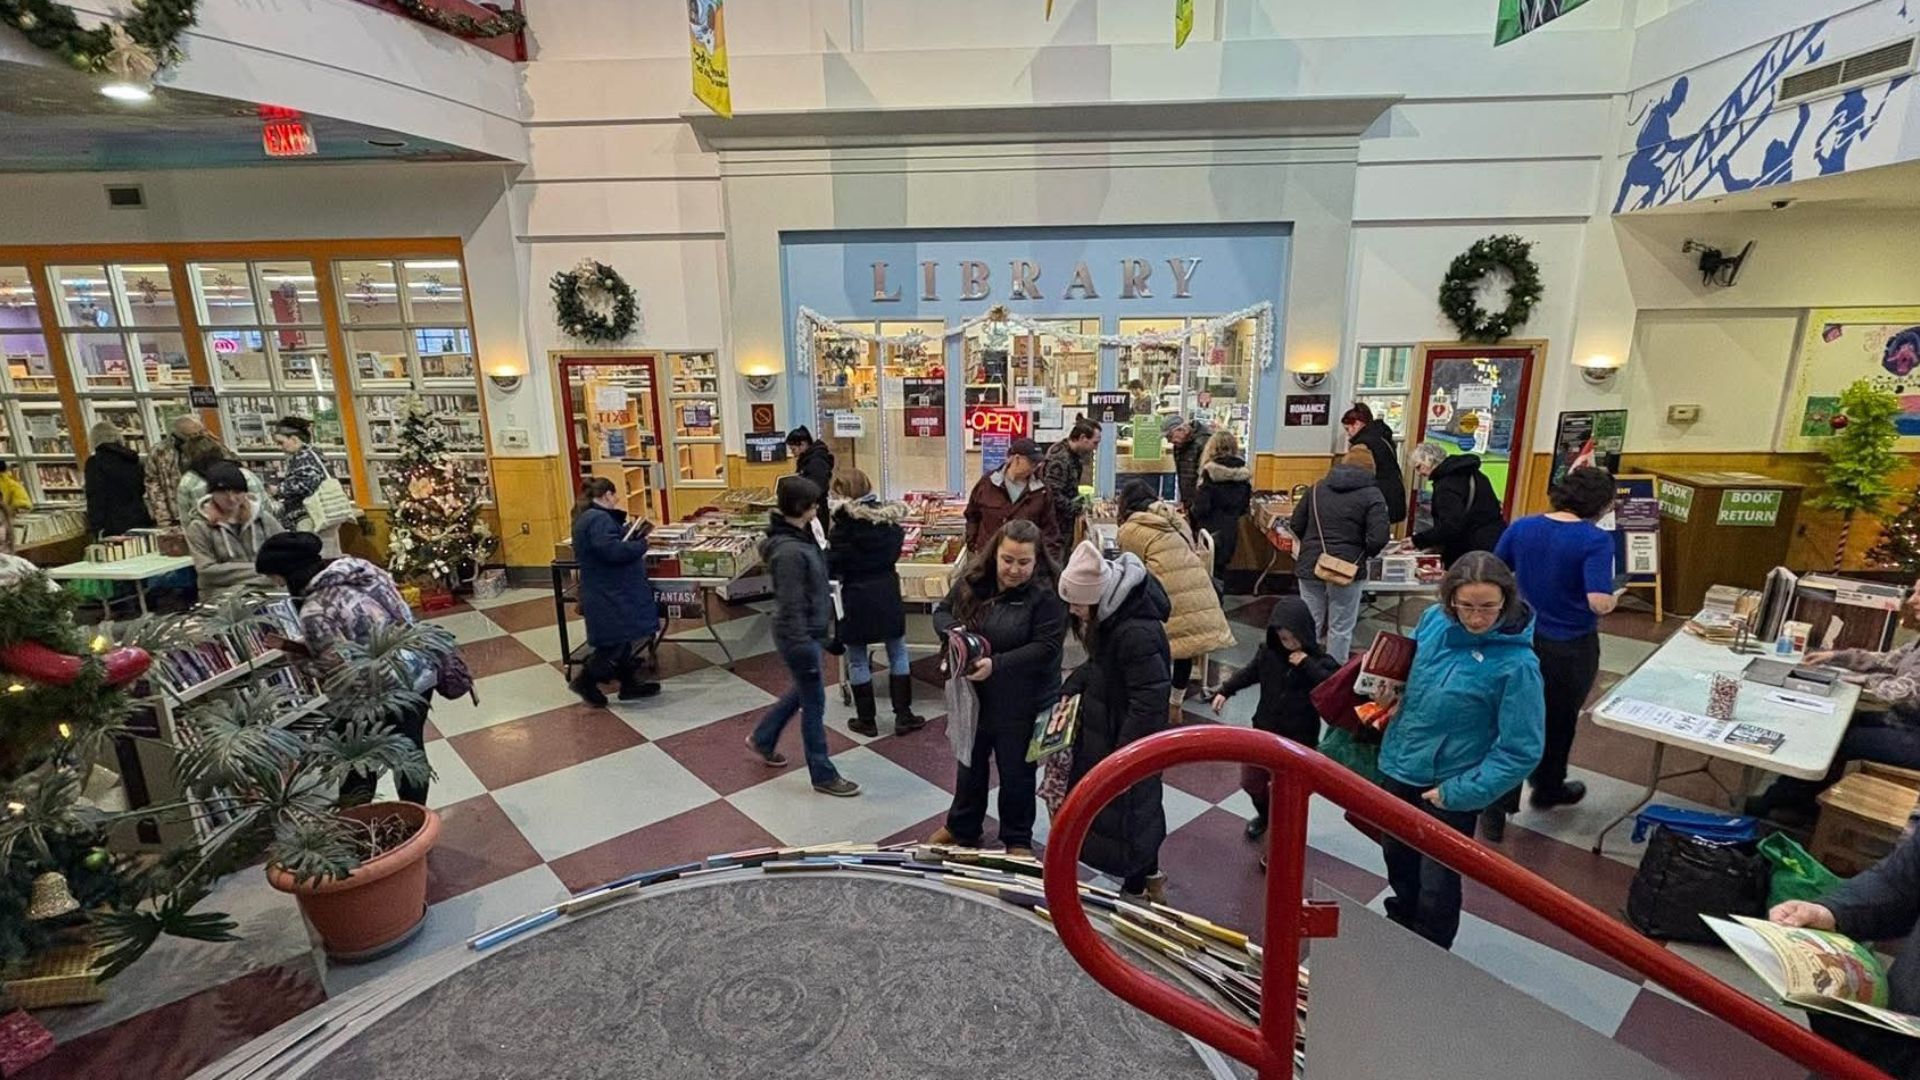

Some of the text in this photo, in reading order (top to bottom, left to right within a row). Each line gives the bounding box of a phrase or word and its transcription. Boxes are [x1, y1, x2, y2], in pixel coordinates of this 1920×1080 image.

[266, 124, 304, 152] EXIT
[871, 257, 1201, 301] LIBRARY
[1092, 394, 1126, 404] MYSTERY
[1289, 404, 1326, 414] ROMANCE
[911, 417, 939, 427] HORROR
[971, 411, 1023, 434] OPEN
[1661, 483, 1689, 499] BOOK
[1730, 492, 1774, 503] BOOK
[1659, 500, 1689, 518] ETURN
[1720, 510, 1777, 522] RETURN
[653, 591, 696, 602] FANTASY
